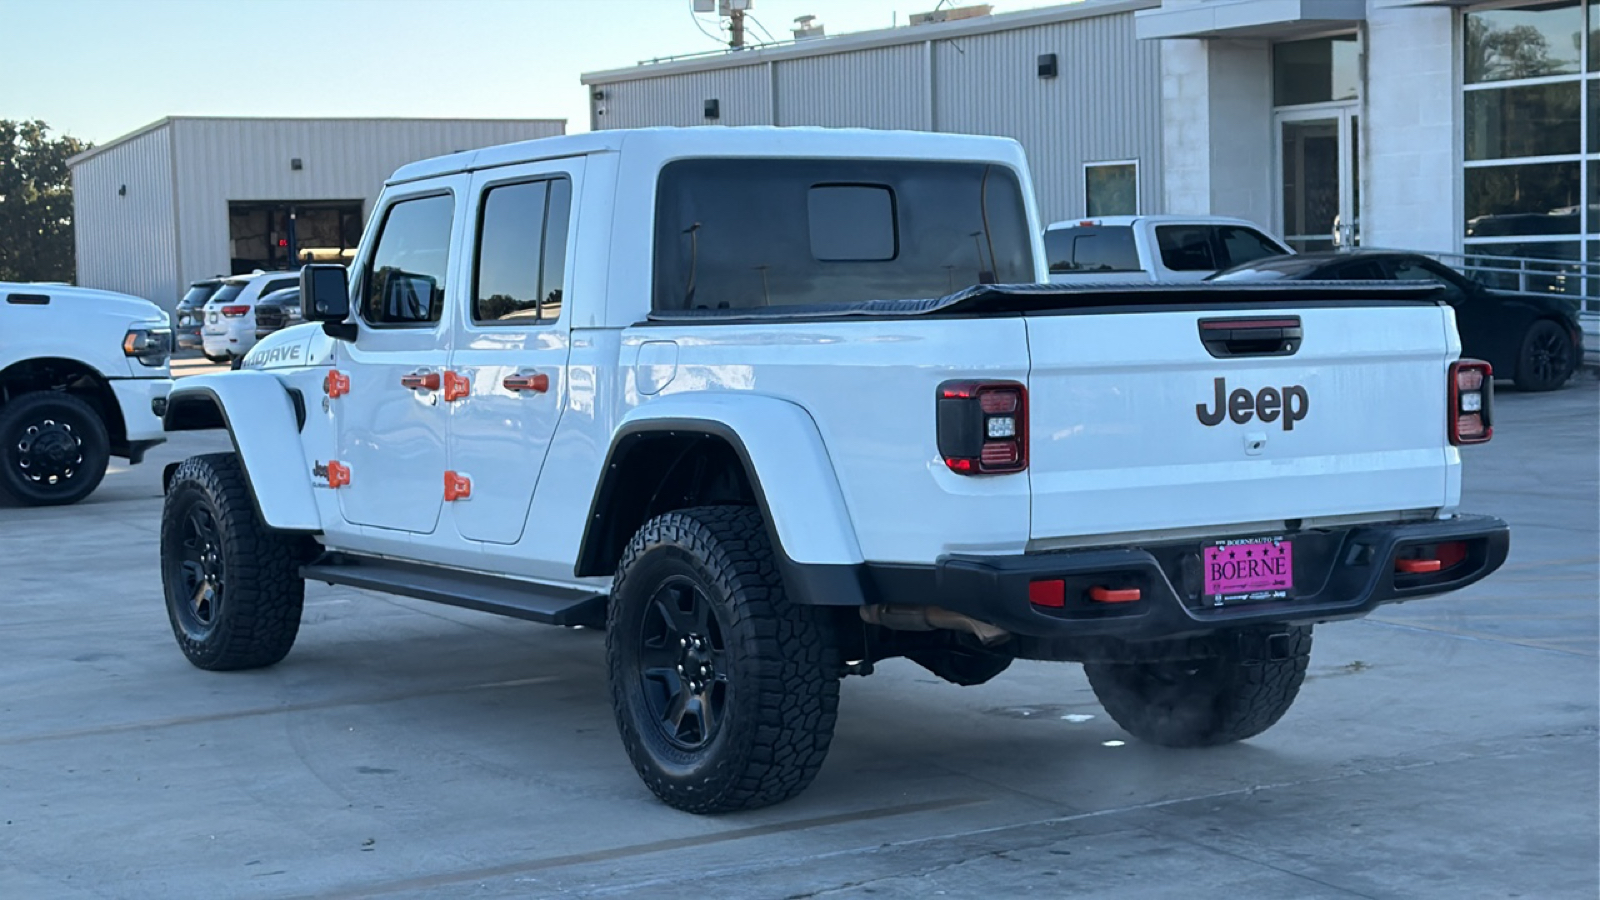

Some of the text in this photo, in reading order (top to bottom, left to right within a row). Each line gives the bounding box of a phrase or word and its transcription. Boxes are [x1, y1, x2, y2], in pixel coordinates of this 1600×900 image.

[1196, 377, 1309, 431] Jeep
[312, 459, 330, 481] Jee
[1211, 557, 1286, 580] BOERNE
